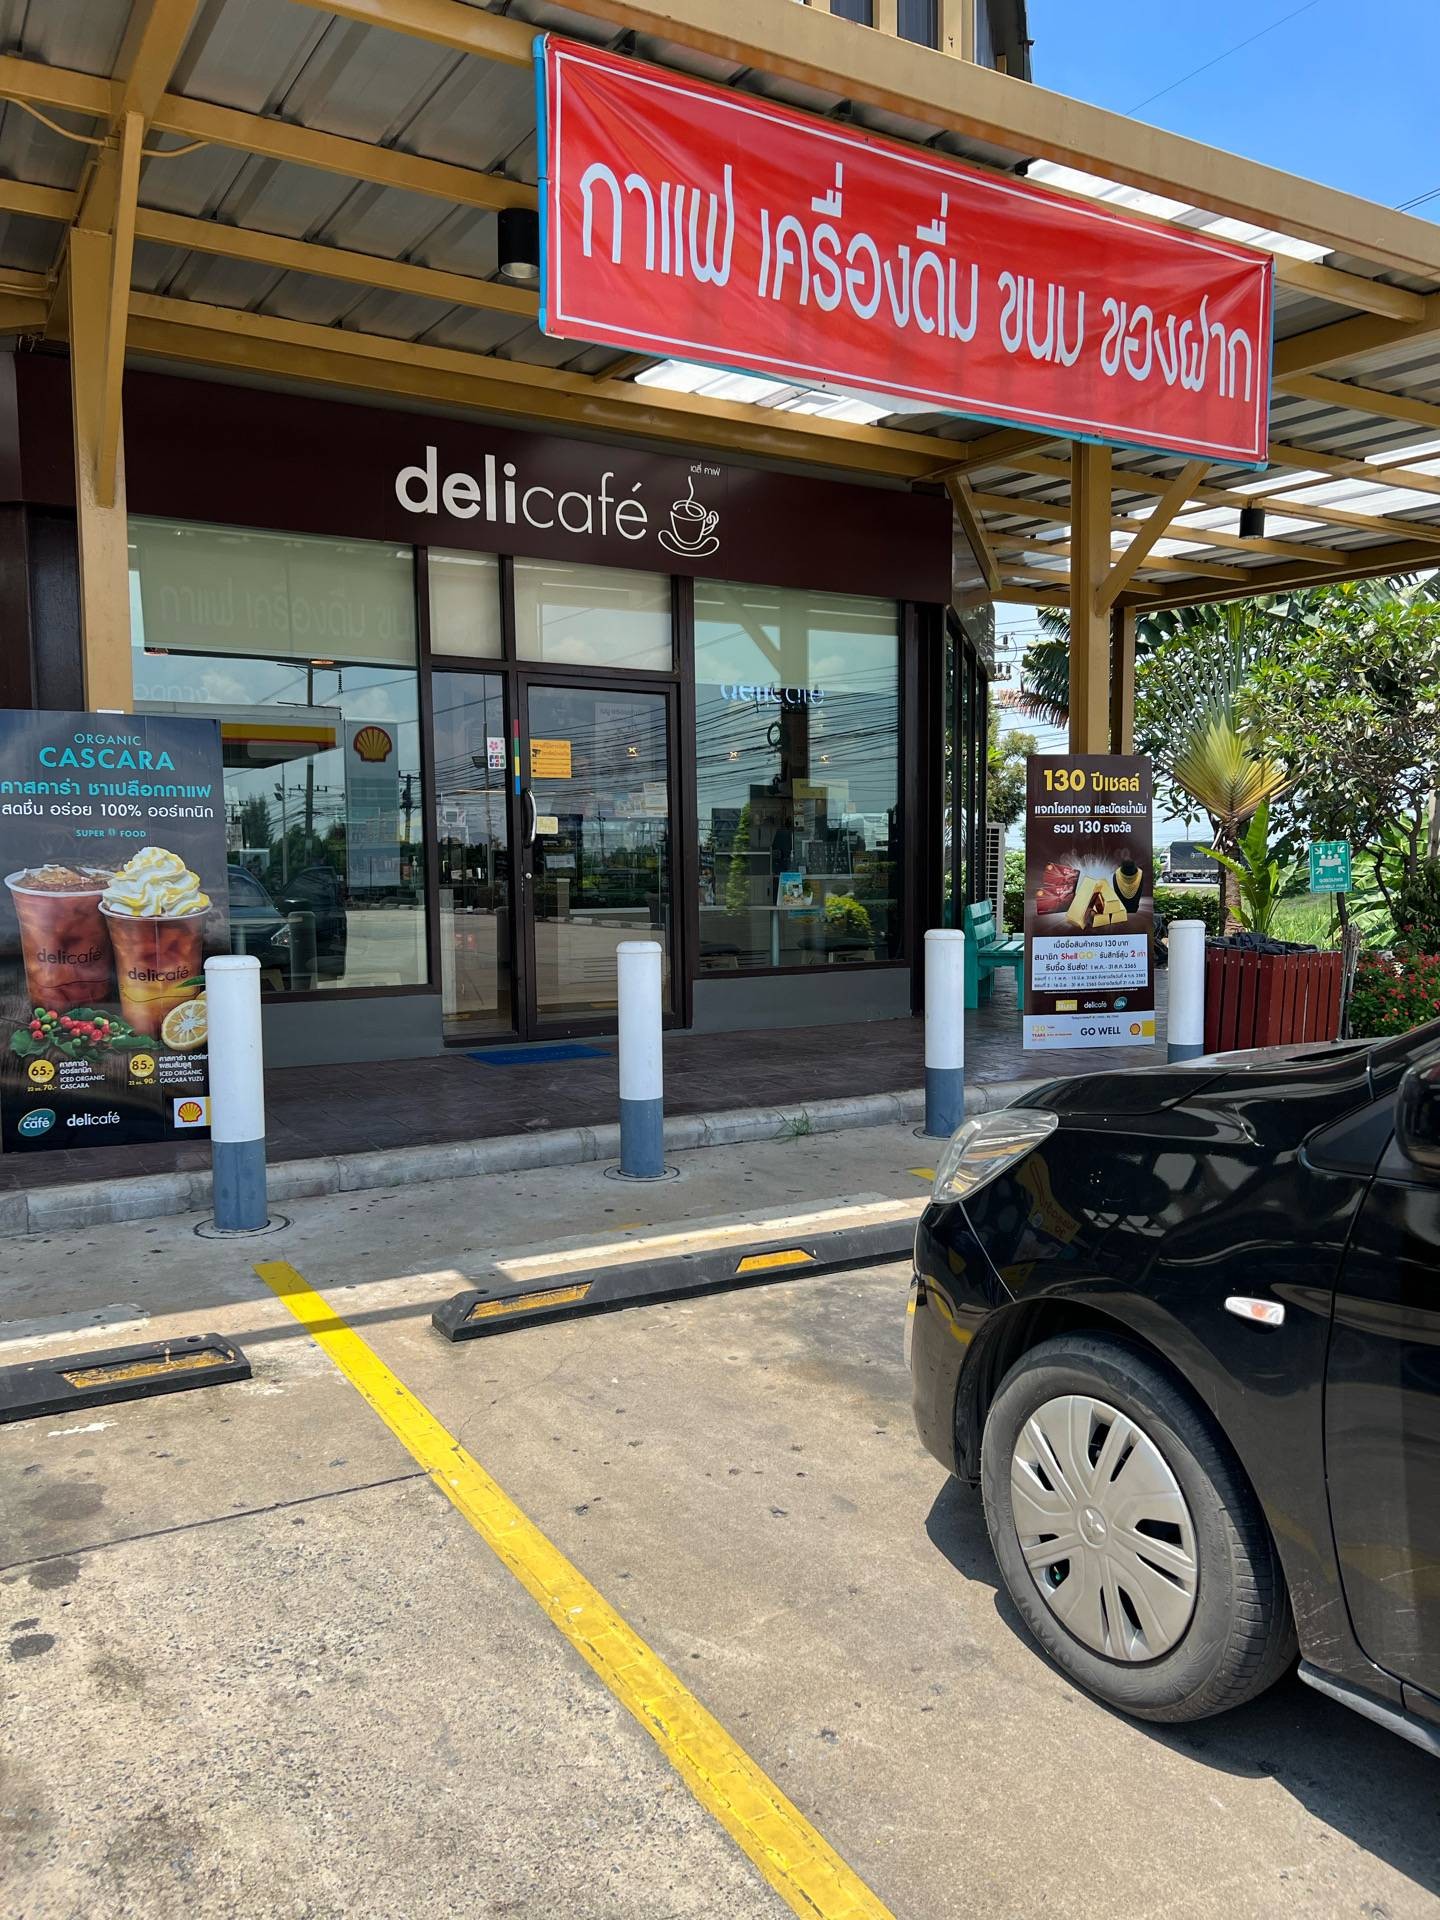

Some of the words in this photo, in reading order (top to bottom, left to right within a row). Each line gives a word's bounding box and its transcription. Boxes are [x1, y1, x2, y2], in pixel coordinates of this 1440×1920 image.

[579, 162, 736, 288] กาแฟ
[757, 160, 979, 344] เครื่องดื่ม
[998, 270, 1086, 368] ขนม
[1100, 294, 1252, 403] ของฝาก
[395, 445, 648, 541] delicafé
[74, 733, 142, 746] ORGANIC
[39, 746, 176, 771] CASCARA
[1, 777, 81, 796] คาสคาร่า
[88, 780, 212, 799] ชาเปลือกกาแฟ
[1043, 769, 1086, 792] 130
[1091, 772, 1140, 792] ปีเชลล์
[2, 798, 44, 816] สดชื่น
[50, 802, 92, 816] อร่อย
[101, 804, 142, 818] 100%
[148, 805, 214, 819] ออร์แกนิก
[1034, 801, 1091, 814] แจกโชคทอง
[1094, 800, 1147, 814] และบัตรน้ำมัน
[76, 828, 105, 838] SUPER
[120, 830, 147, 839] FOOD
[1053, 824, 1075, 834] รวม
[1078, 820, 1101, 834] 130
[1103, 821, 1132, 833] รางวัล
[1105, 940, 1117, 948] 130
[36, 947, 104, 966] delicafé
[1060, 951, 1078, 960] Shell
[1130, 950, 1136, 958] 2
[128, 967, 190, 983] delicafé
[1080, 1028, 1096, 1036] GO
[1098, 1027, 1121, 1035] WELL
[75, 1074, 105, 1082] ORGANIC
[23, 1117, 50, 1129] café
[67, 1111, 120, 1127] delicafé
